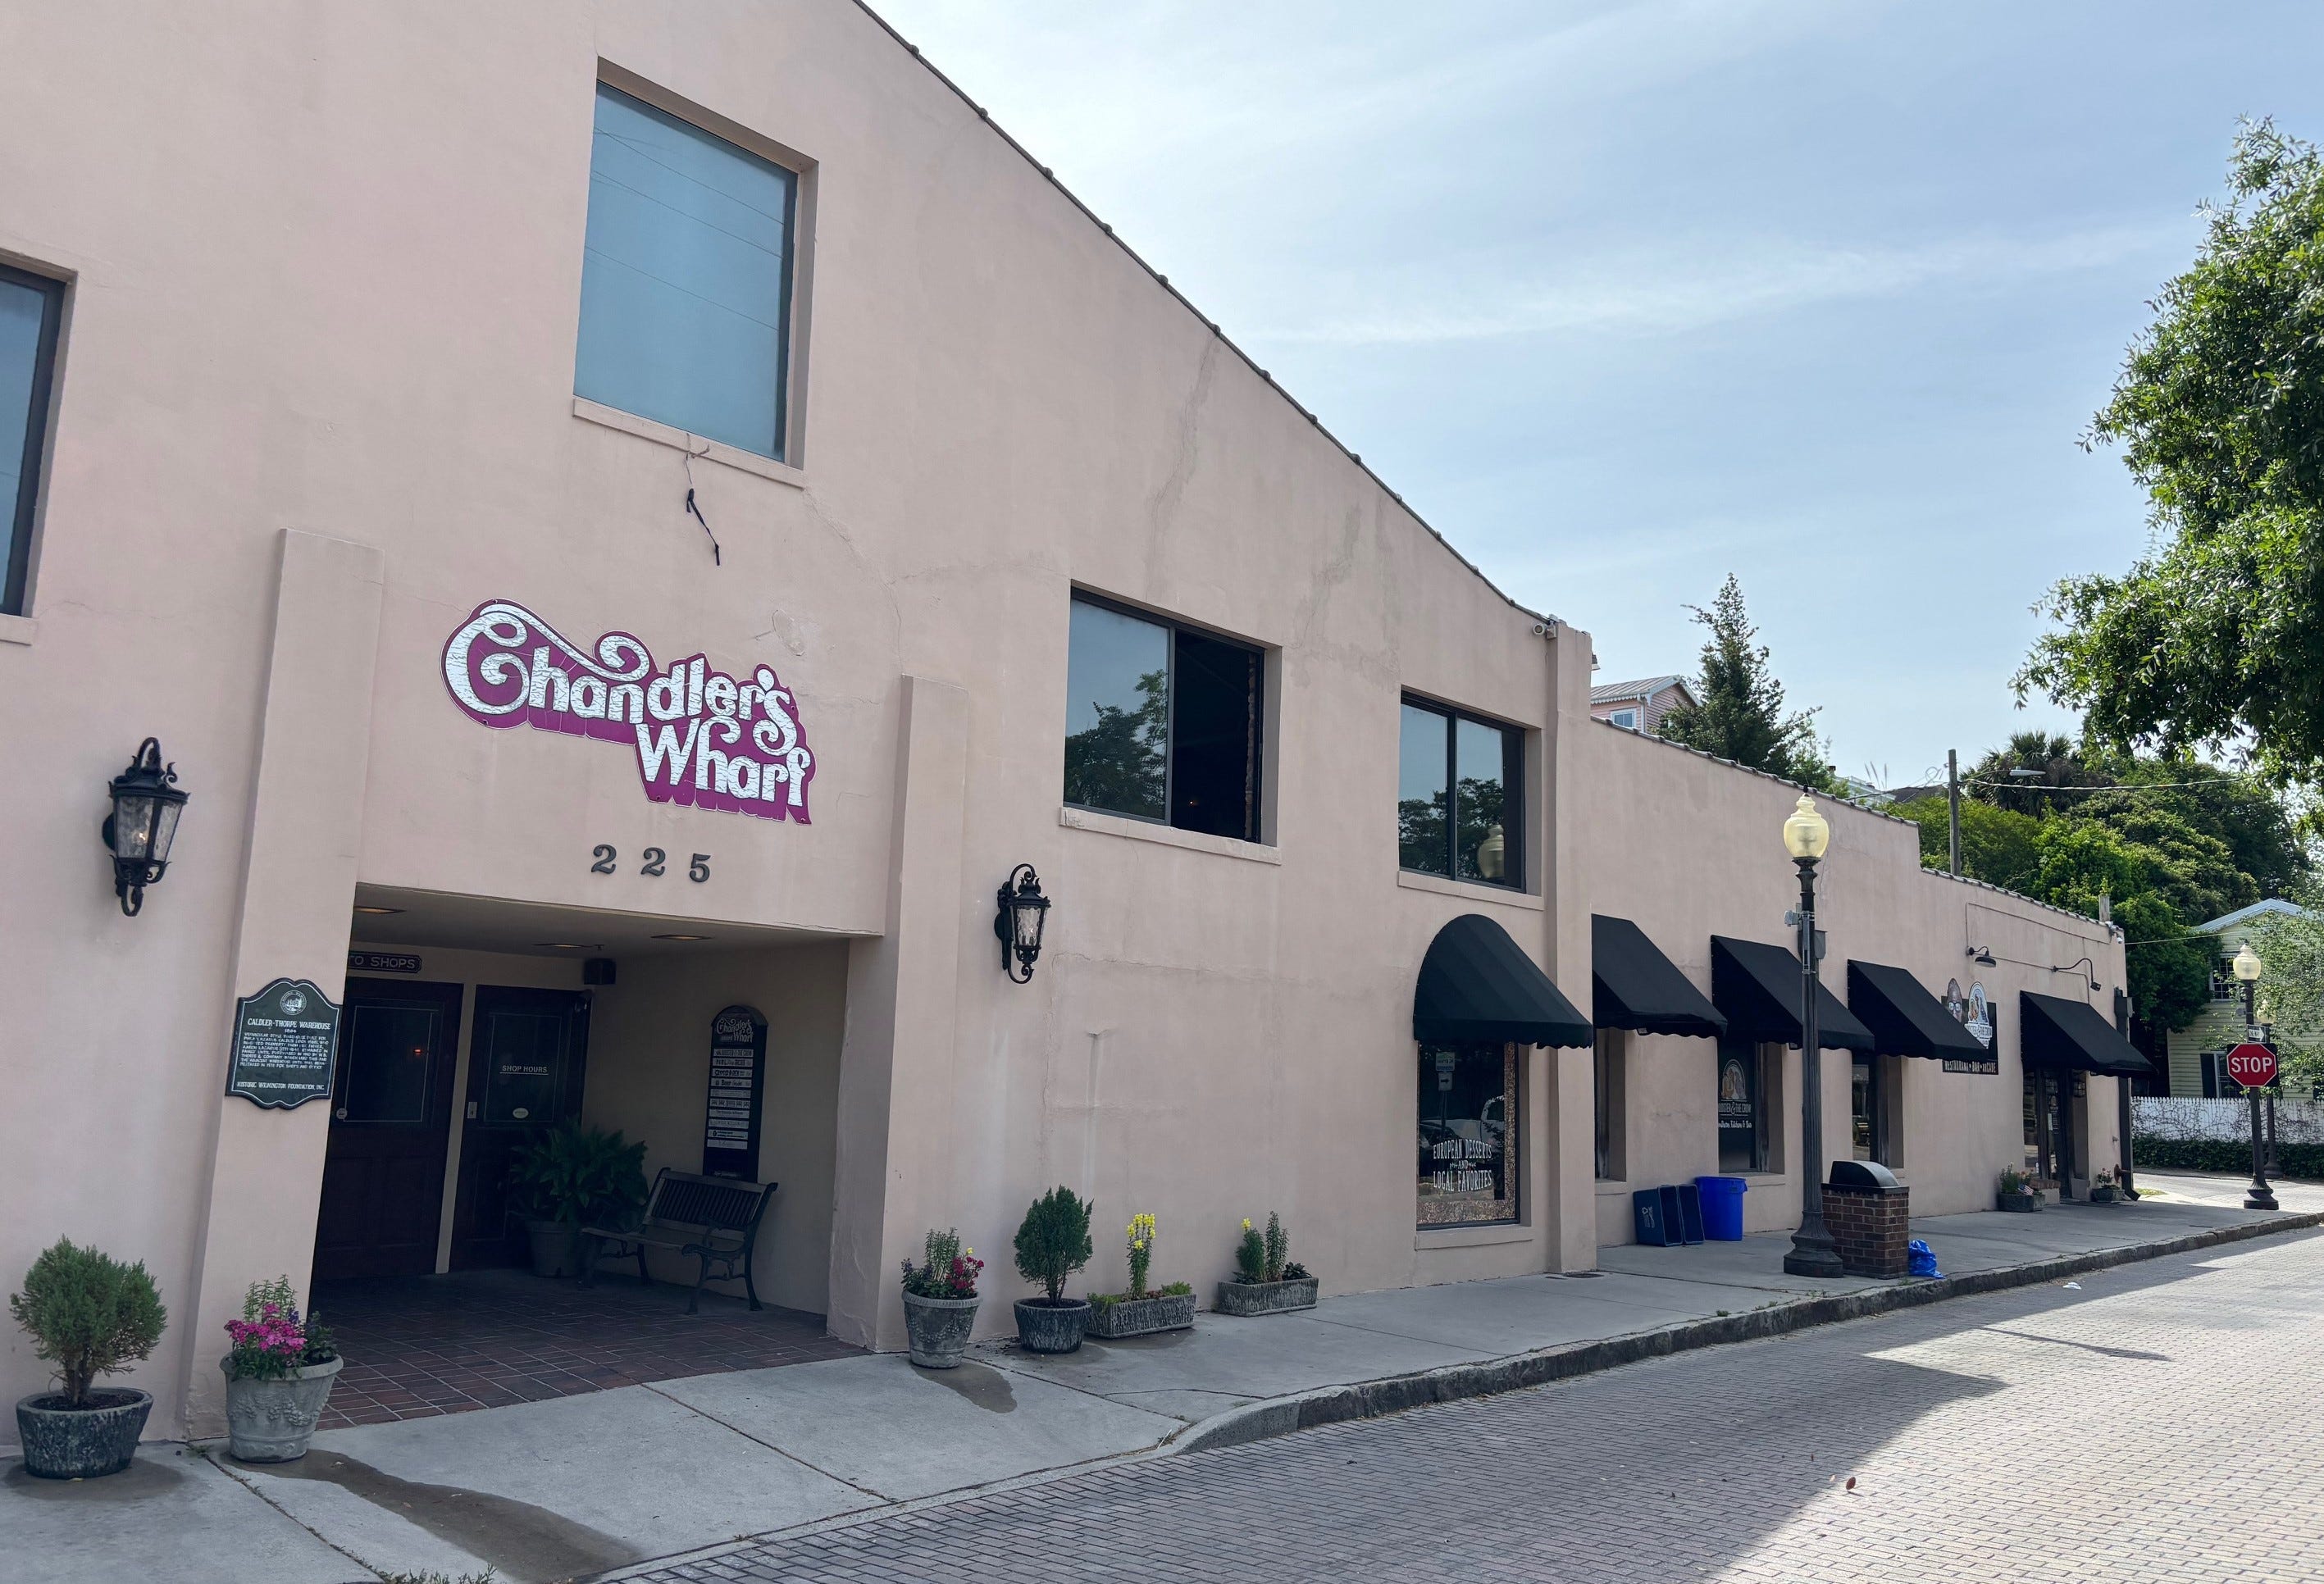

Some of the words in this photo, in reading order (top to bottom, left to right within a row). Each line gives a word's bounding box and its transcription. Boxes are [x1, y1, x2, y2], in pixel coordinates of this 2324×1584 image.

[441, 603, 797, 757] Chandler's
[634, 714, 812, 807] Wharf
[370, 957, 415, 969] SHOPS
[299, 1022, 331, 1030] WAREHOUSE
[716, 1017, 753, 1036] Chandler's
[733, 1031, 754, 1044] Wharf
[523, 1066, 548, 1074] HOURS
[2231, 1057, 2272, 1073] STOP
[1433, 1139, 1462, 1160] EUROPEAN
[1465, 1139, 1492, 1159] DESSERTS
[1458, 1159, 1469, 1170] AND
[1433, 1171, 1455, 1192] LOCAL
[1458, 1170, 1492, 1193] FAVORITES
